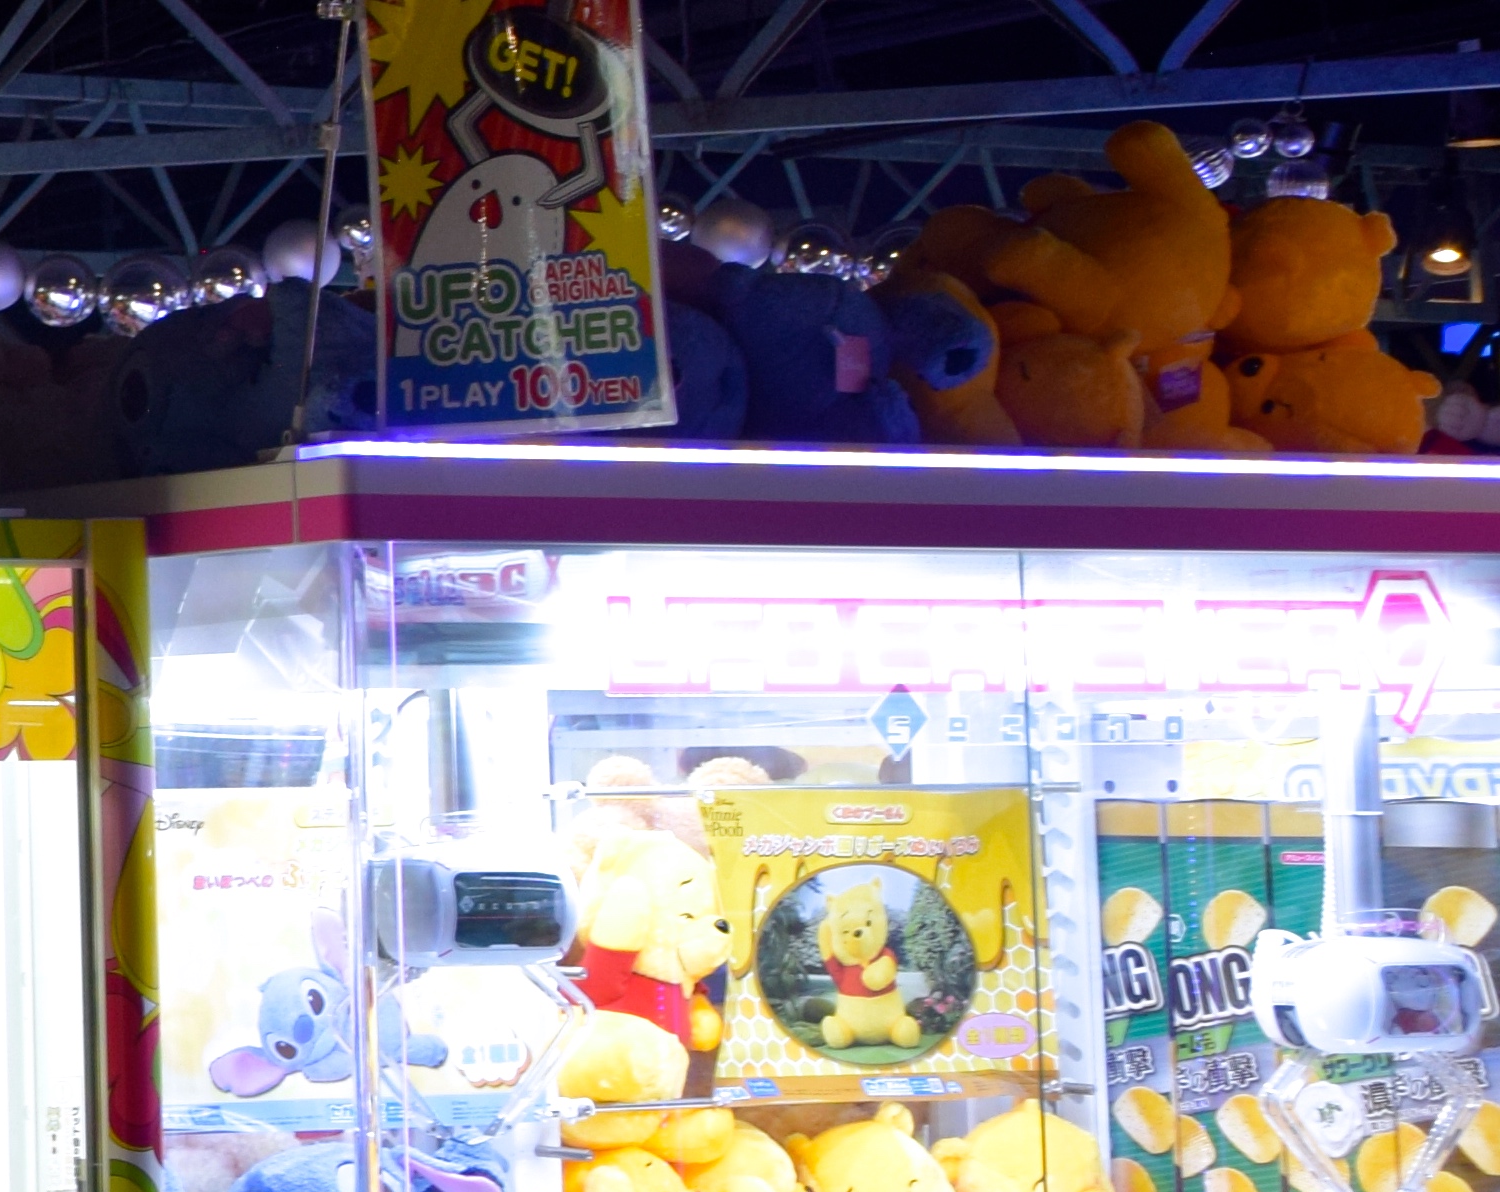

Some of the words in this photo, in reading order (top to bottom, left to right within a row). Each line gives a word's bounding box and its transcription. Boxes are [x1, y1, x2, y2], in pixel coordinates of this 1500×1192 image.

[489, 31, 578, 98] GET!
[400, 268, 517, 321] UFO
[427, 309, 640, 362] CATCHER
